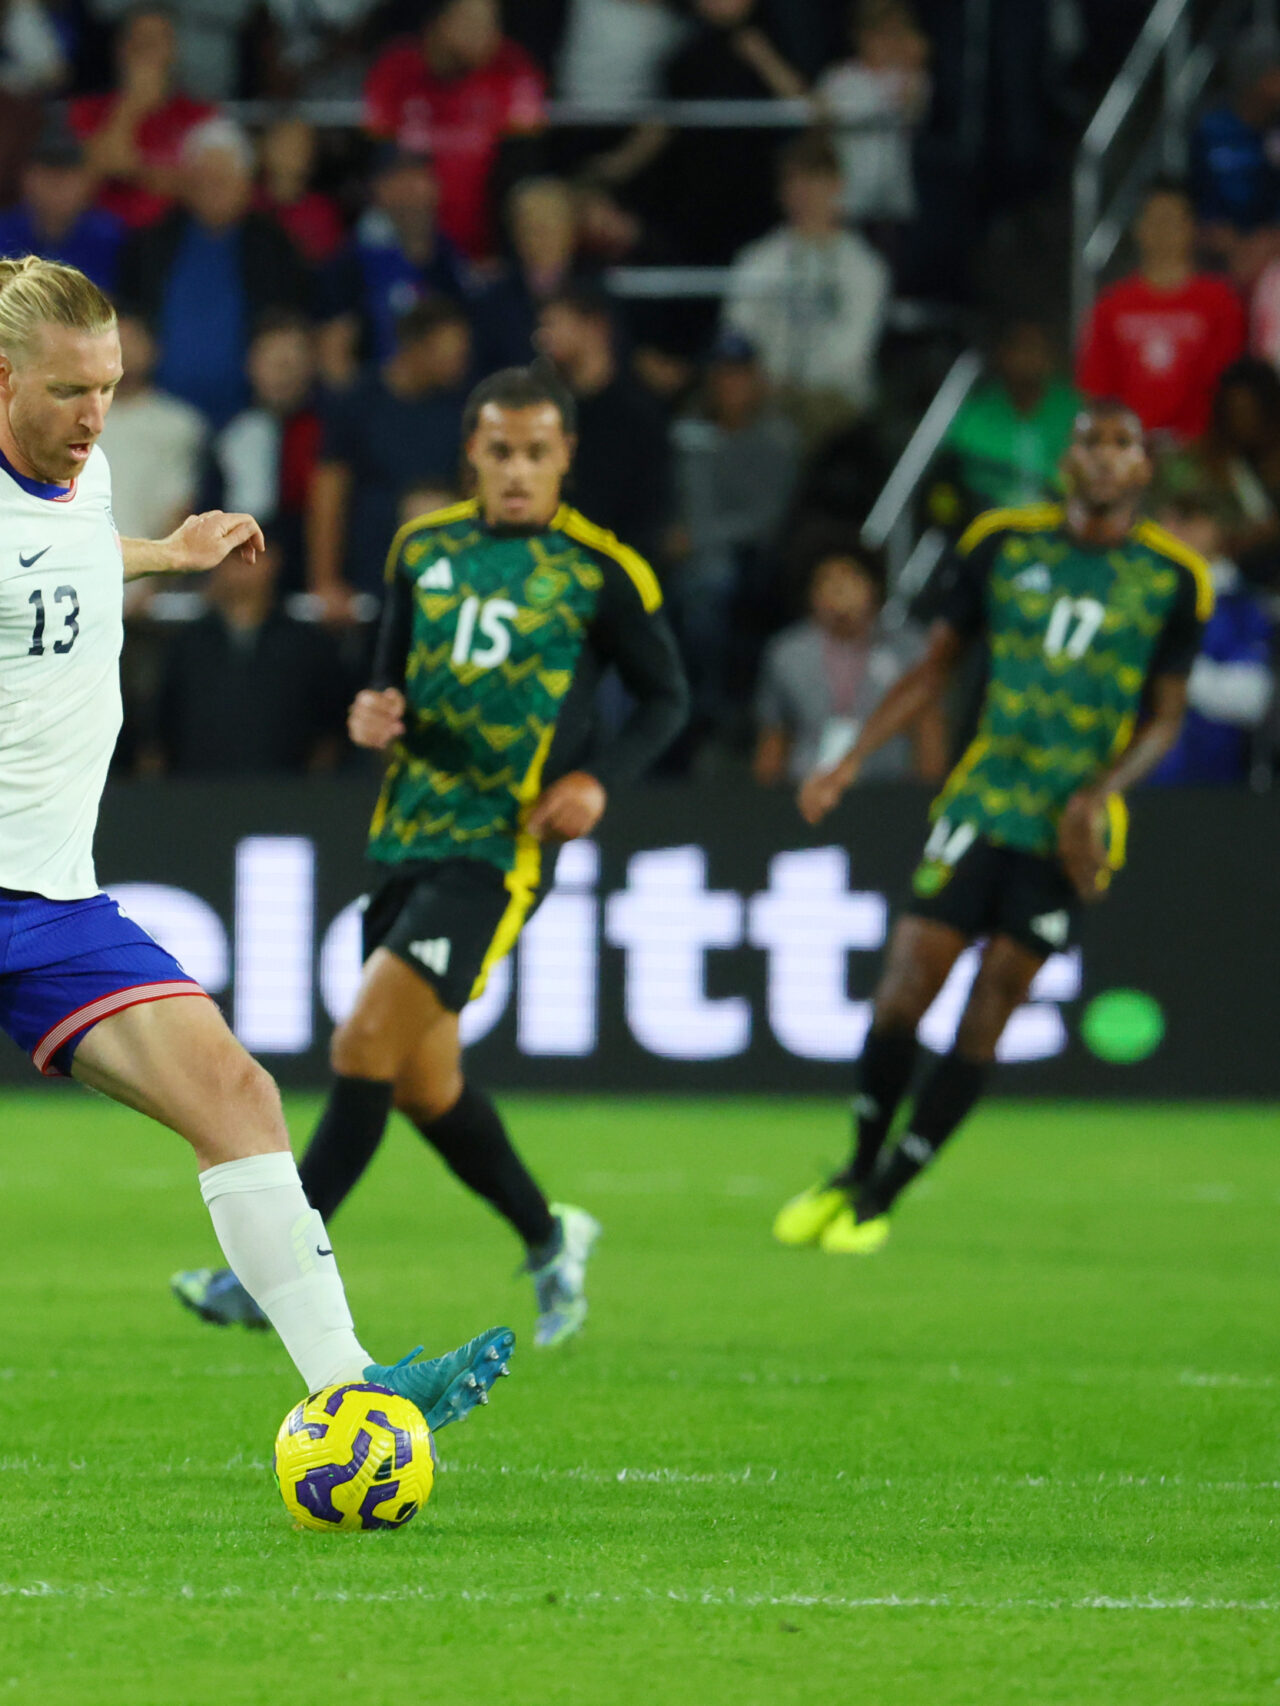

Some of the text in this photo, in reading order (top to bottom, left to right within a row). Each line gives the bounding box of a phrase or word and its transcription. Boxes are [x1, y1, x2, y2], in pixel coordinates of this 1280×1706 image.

[27, 584, 80, 656] 13
[451, 596, 519, 669] 15
[1042, 597, 1106, 660] 17
